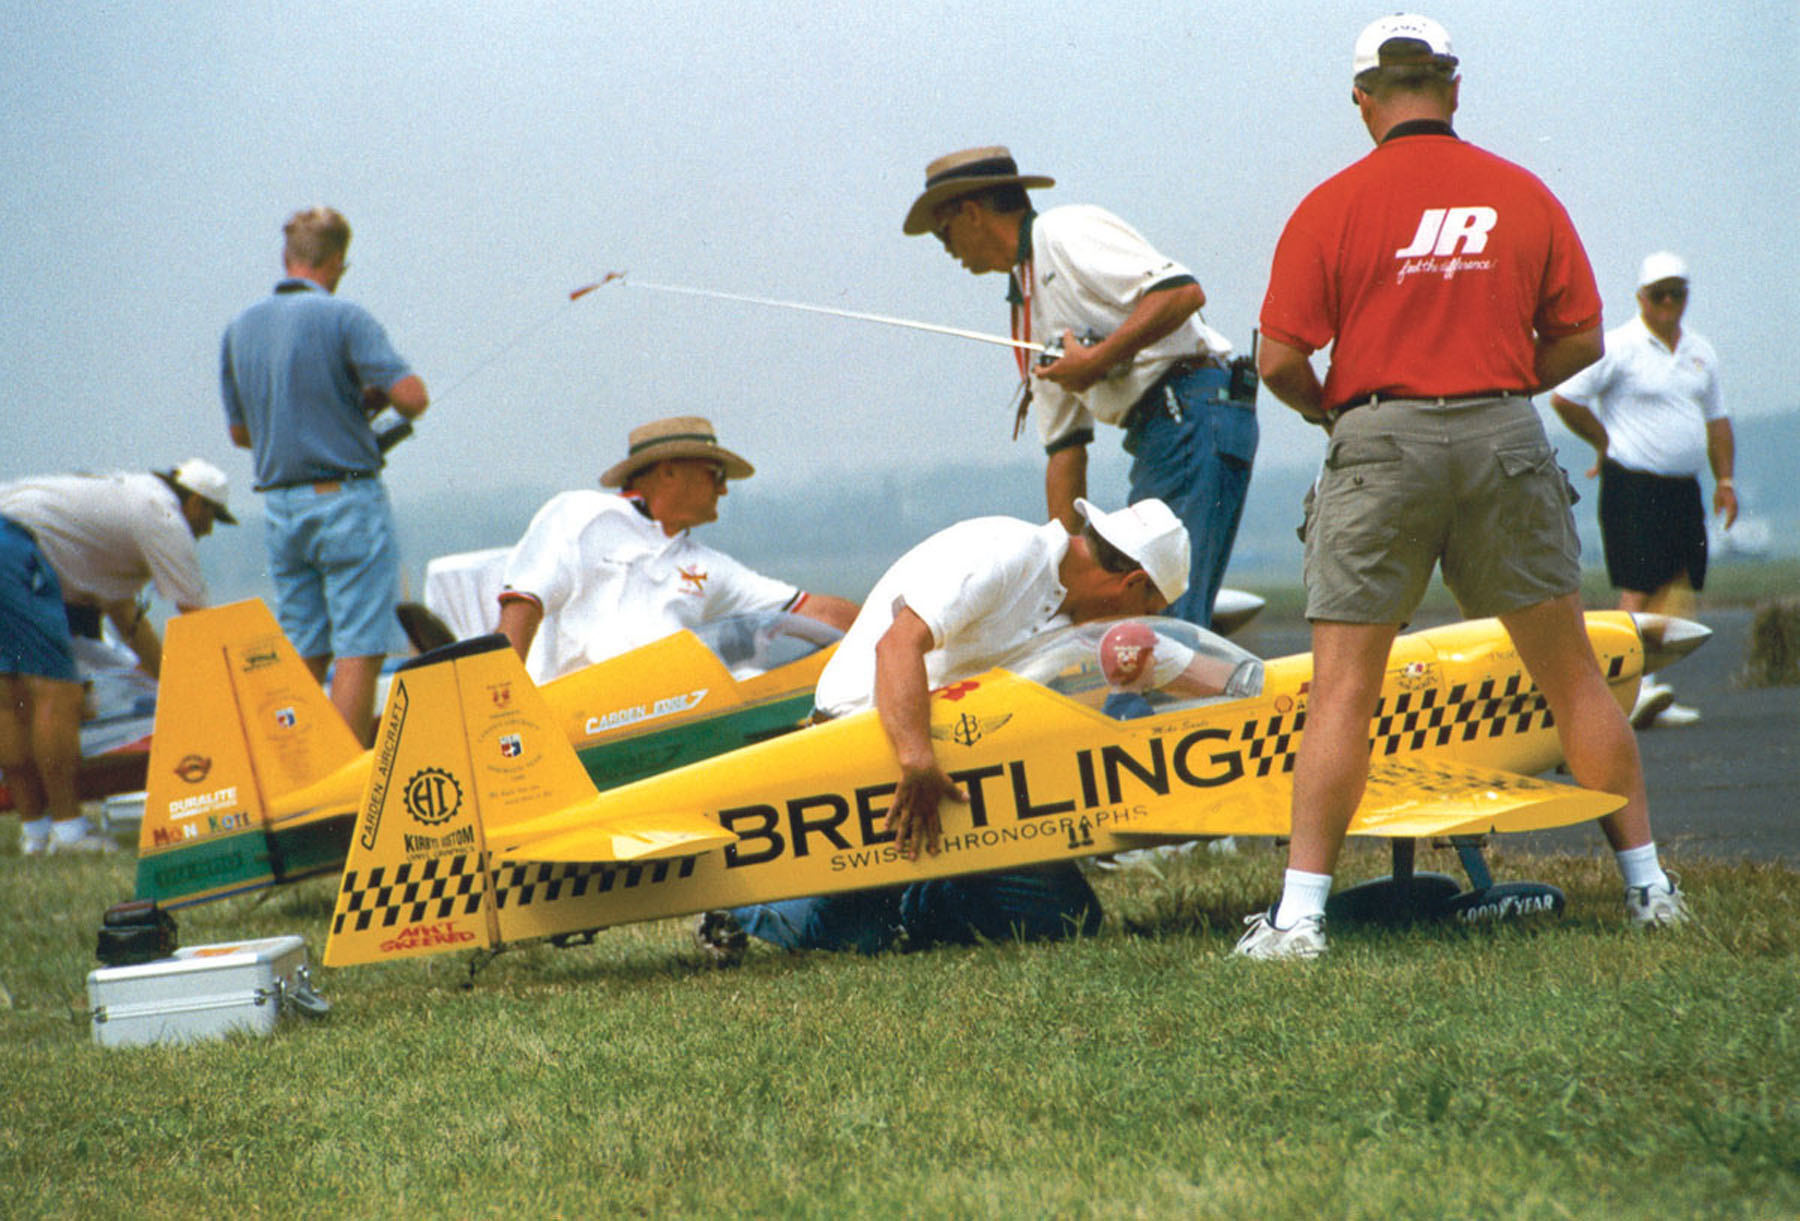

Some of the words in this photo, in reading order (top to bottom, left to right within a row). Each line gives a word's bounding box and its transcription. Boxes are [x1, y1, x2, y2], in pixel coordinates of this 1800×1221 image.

[1395, 206, 1498, 258] JR
[361, 783, 384, 851] CARDEN
[377, 702, 403, 777] AIRCRAFT
[718, 728, 1245, 869] BRETLING
